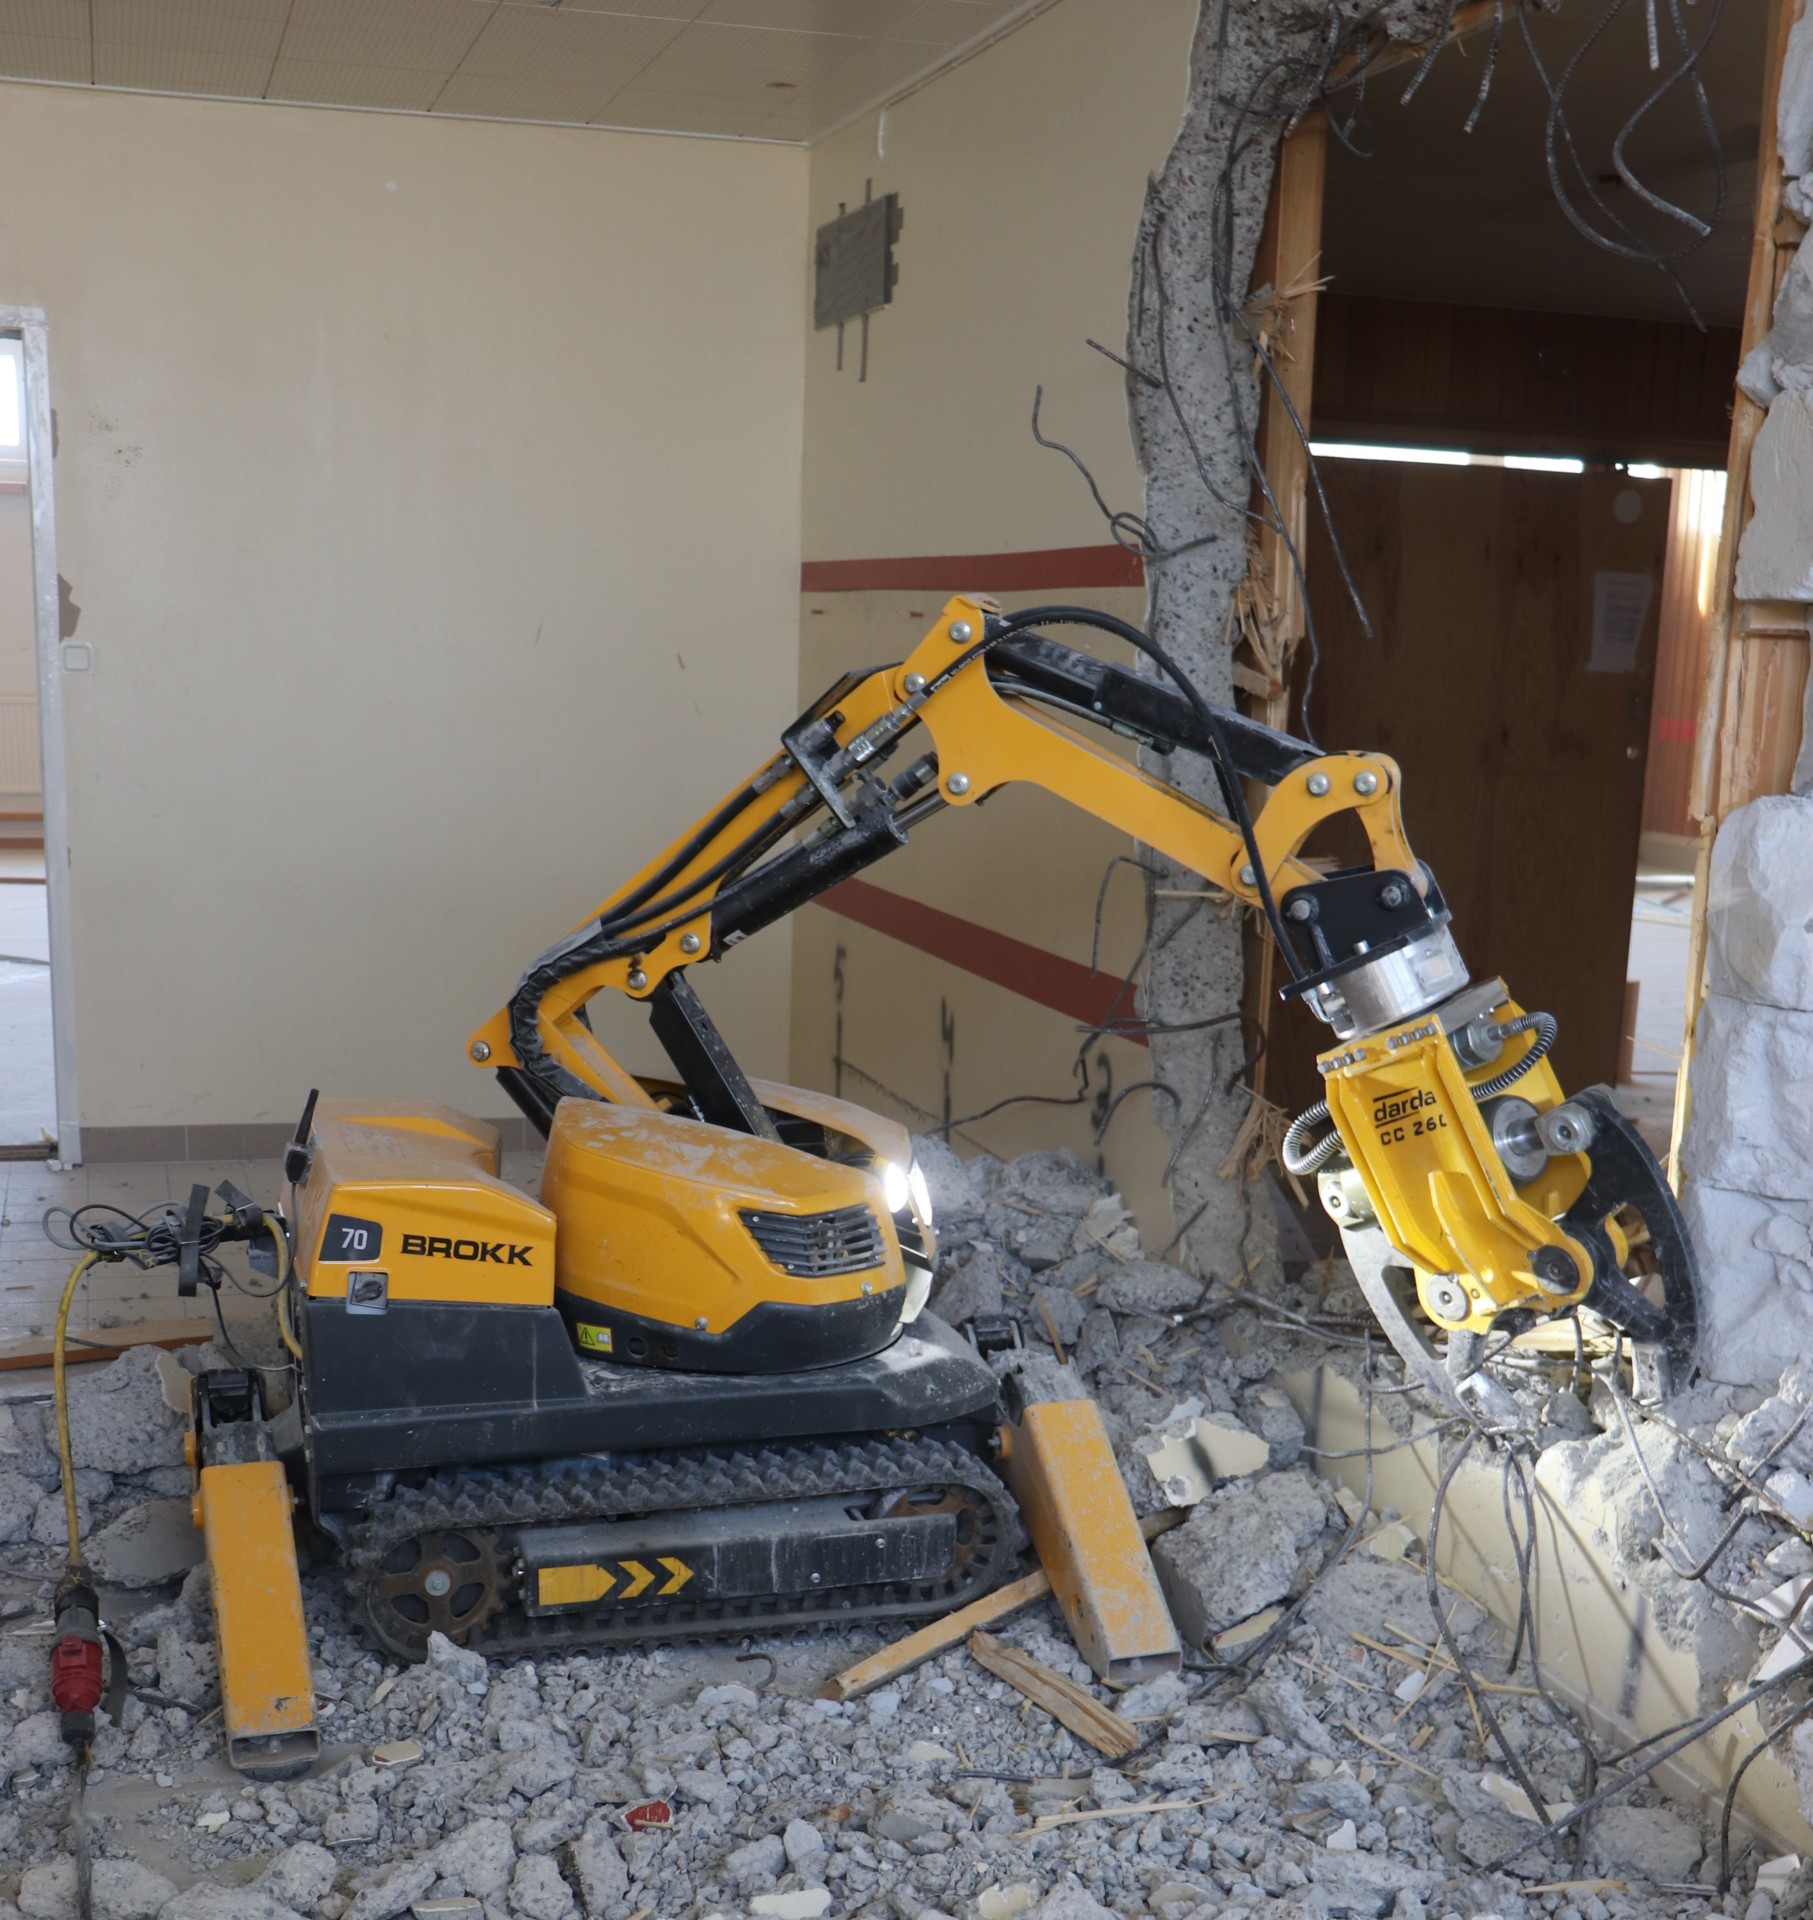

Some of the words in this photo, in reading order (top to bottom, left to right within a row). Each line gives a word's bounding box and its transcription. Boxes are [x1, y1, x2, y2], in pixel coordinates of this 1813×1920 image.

[1373, 1089, 1437, 1123] darda
[1380, 1126, 1405, 1146] CC
[341, 1227, 368, 1250] 70
[401, 1233, 534, 1267] BROKK
